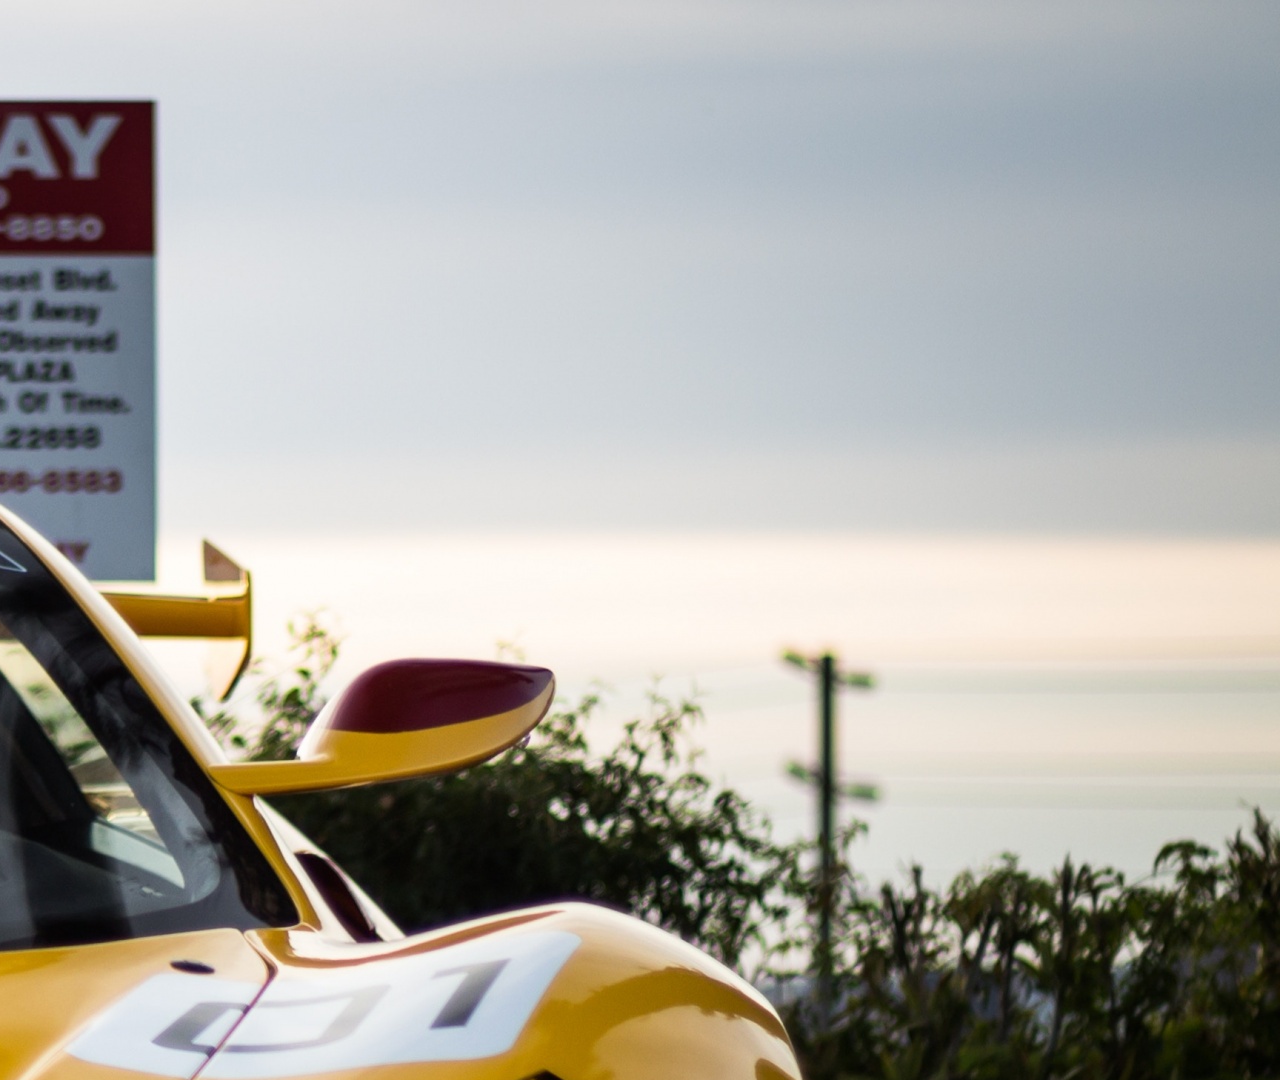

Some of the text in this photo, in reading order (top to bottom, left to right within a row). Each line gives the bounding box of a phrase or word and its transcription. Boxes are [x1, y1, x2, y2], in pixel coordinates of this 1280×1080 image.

[51, 267, 119, 292] Blvd.
[29, 298, 102, 328] Away
[16, 389, 51, 415] Of
[60, 389, 134, 415] Time.
